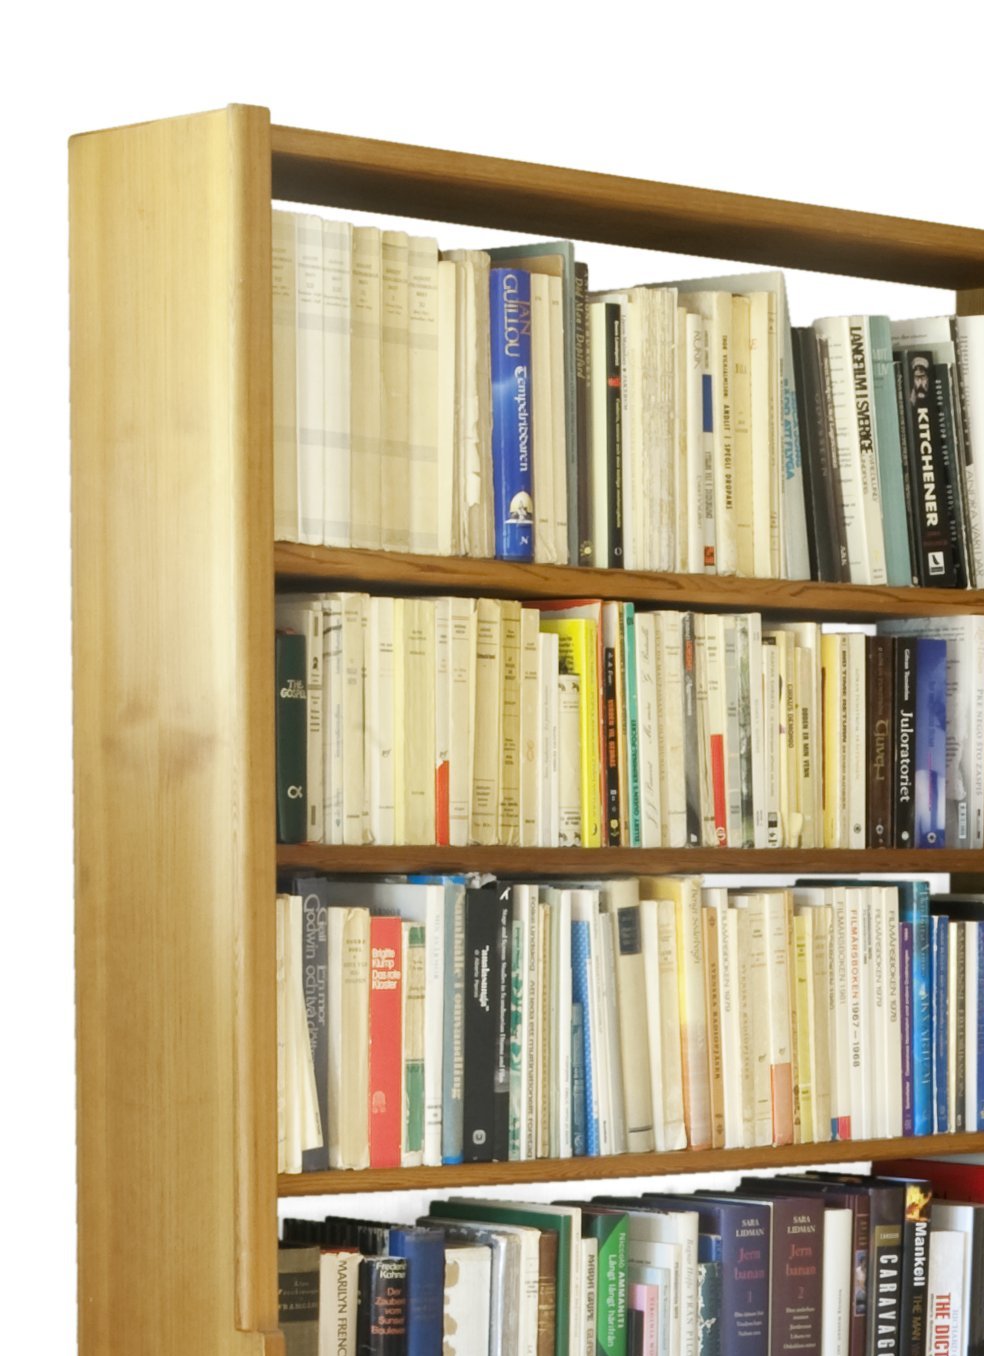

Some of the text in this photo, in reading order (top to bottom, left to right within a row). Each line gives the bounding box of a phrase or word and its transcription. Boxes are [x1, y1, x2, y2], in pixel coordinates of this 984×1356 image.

[503, 273, 520, 358] GUILLOU
[518, 300, 531, 335] JAN
[856, 401, 873, 454] SVERIGE
[785, 440, 796, 479] FLYGA
[917, 407, 938, 527] KITCHENER
[900, 709, 914, 803] Juloratoriet
[304, 894, 320, 959] Godwin
[850, 909, 859, 1000] FILMÅRSBOKEN
[888, 910, 898, 996] FILMÅRSBOKEN
[305, 964, 318, 995] och
[318, 992, 326, 1027] mor
[852, 1041, 860, 1068] 1968
[735, 1228, 765, 1237] LIDMAN
[741, 1218, 760, 1226] SARA
[787, 1225, 816, 1234] LIDMAN
[792, 1215, 811, 1224] SARA
[606, 1254, 617, 1281] Långt
[738, 1247, 761, 1263] Jern
[789, 1244, 813, 1260] Jern
[912, 1222, 927, 1287] Mankell
[734, 1267, 765, 1281] banan
[786, 1264, 817, 1277] banan
[337, 1259, 349, 1314] MARILYN
[606, 1283, 617, 1307] långt
[617, 1271, 625, 1328] AMMANITI
[912, 1295, 923, 1314] THE
[935, 1292, 951, 1320] THE
[911, 1316, 921, 1341] MAN
[950, 1309, 959, 1352] RICHARD
